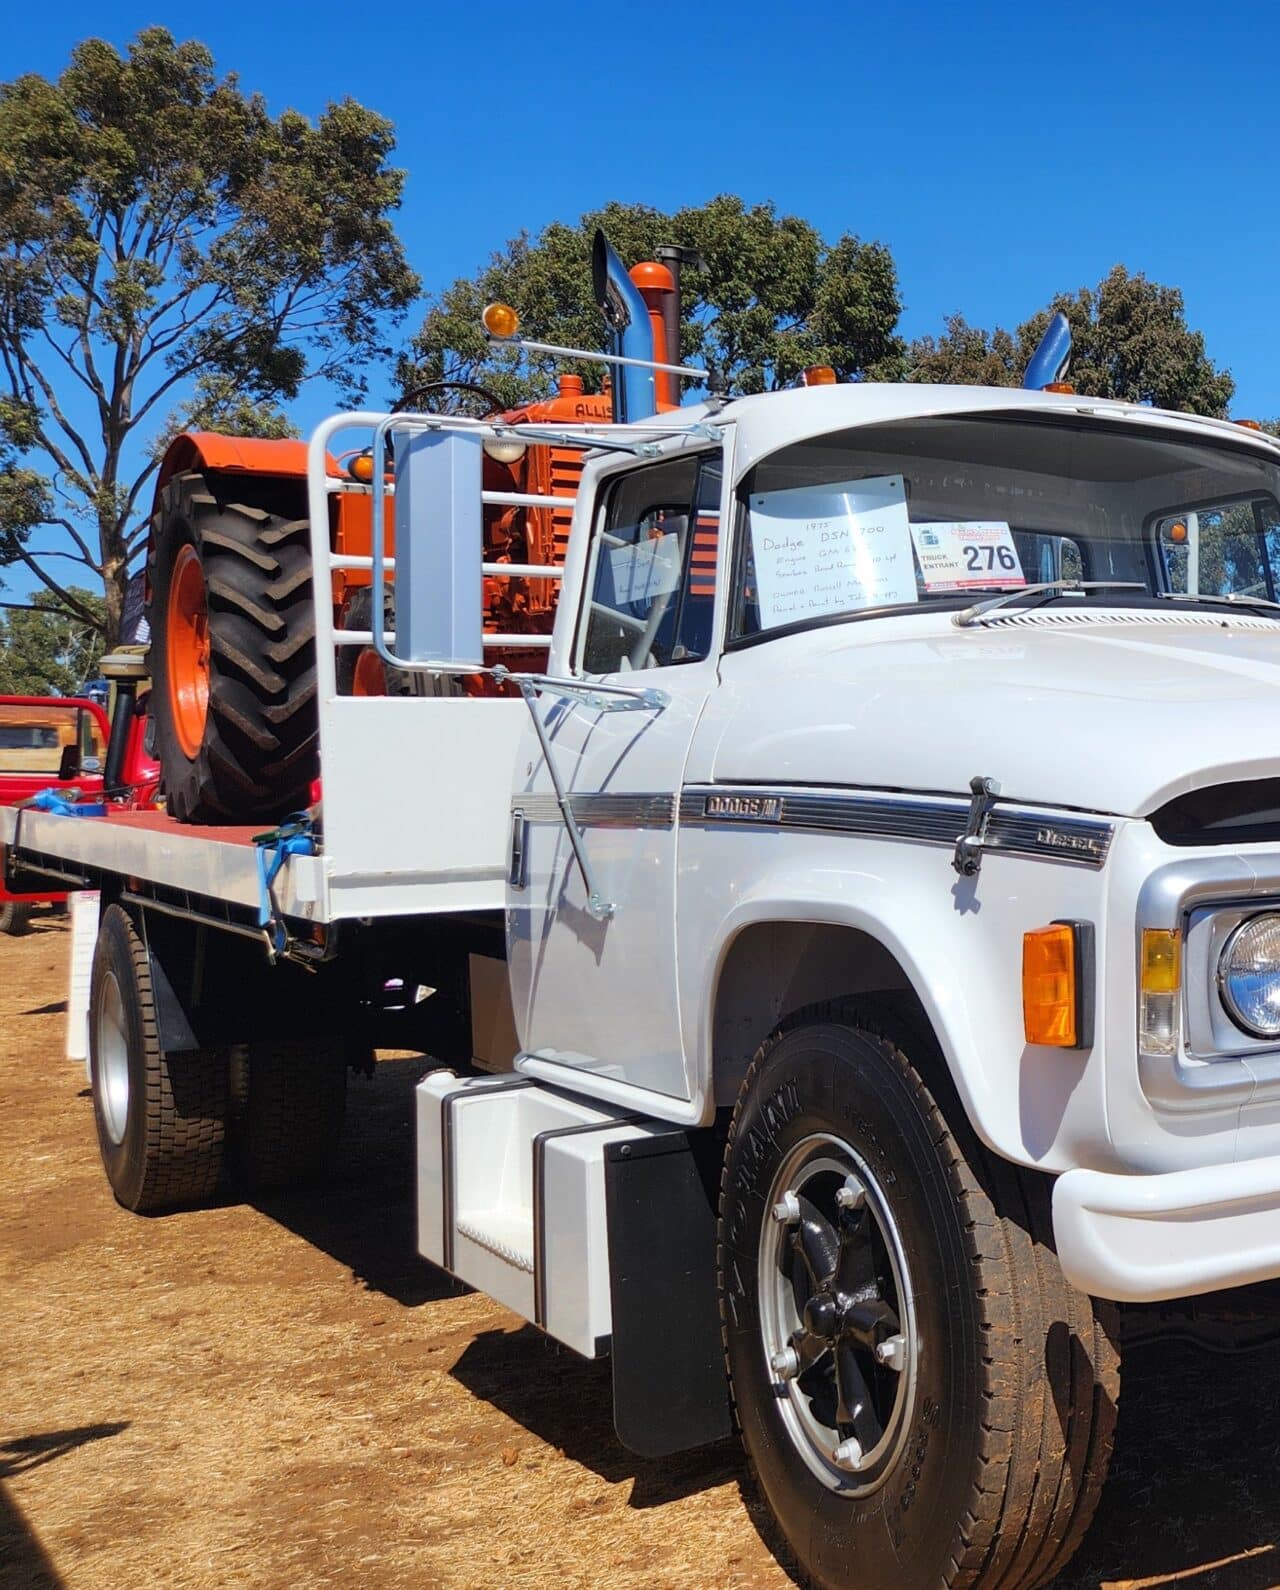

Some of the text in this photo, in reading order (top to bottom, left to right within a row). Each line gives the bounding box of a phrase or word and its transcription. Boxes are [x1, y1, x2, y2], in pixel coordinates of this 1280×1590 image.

[763, 526, 885, 552] Dodge DSN 700
[921, 554, 948, 562] TRUCK
[924, 561, 960, 570] ENTRANT
[963, 545, 1016, 571] 276
[708, 796, 759, 815] DODGE
